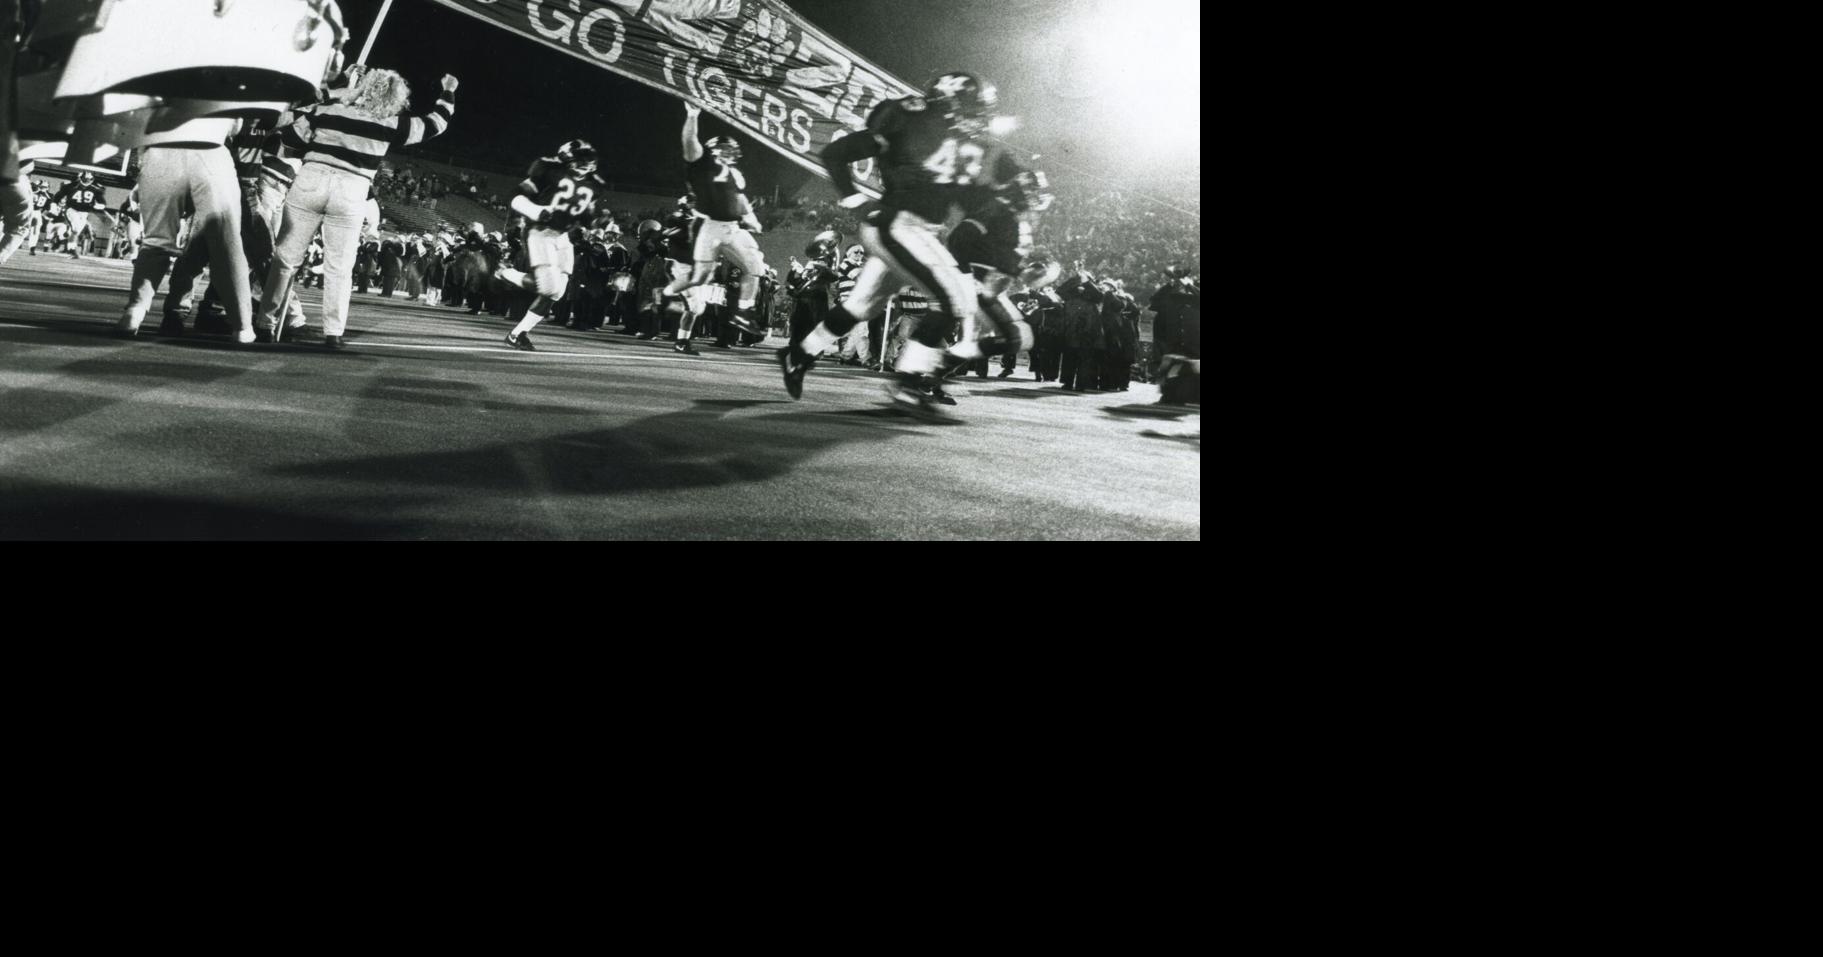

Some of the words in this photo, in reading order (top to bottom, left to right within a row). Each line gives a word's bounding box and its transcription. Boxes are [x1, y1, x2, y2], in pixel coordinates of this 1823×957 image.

[527, 0, 626, 63] GO
[657, 42, 813, 154] TIGERS
[72, 190, 95, 203] 49
[552, 177, 594, 216] 23
